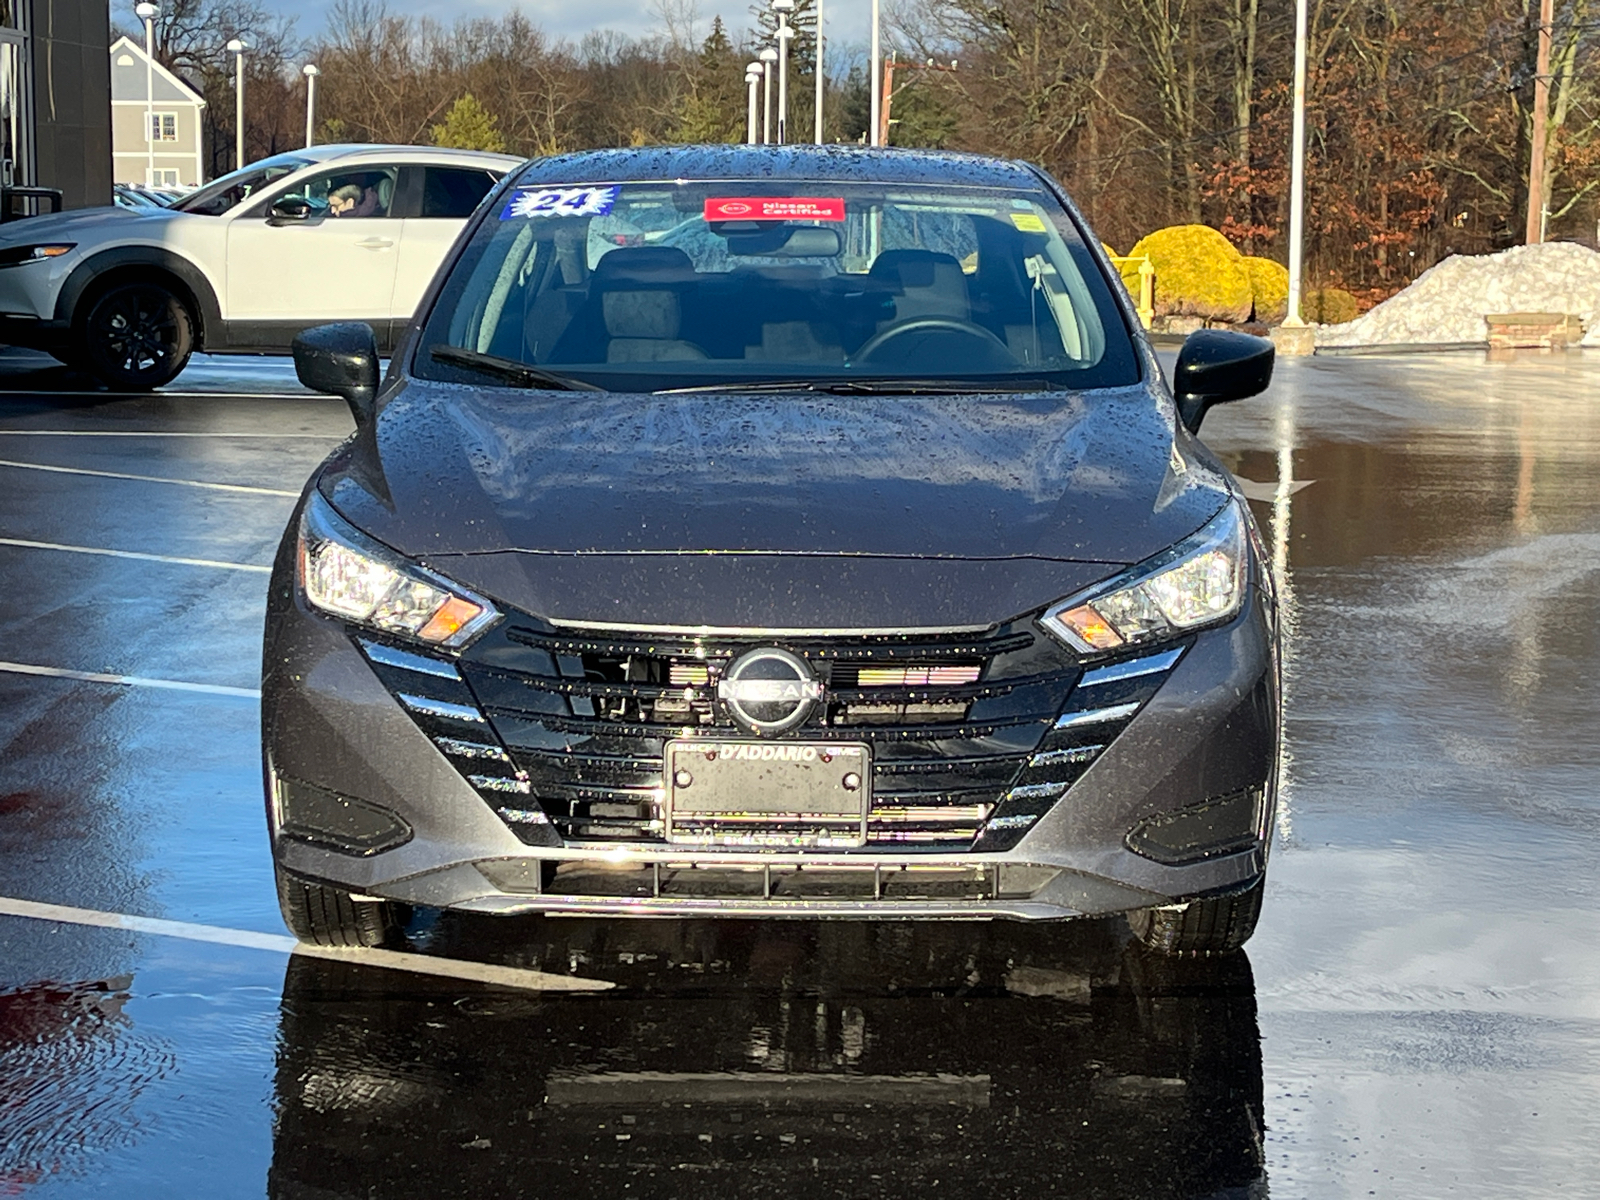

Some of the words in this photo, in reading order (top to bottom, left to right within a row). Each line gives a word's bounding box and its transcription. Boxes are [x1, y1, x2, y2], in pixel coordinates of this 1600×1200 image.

[530, 193, 591, 211] 24
[762, 208, 832, 216] Certified
[721, 683, 818, 698] NISAN
[719, 744, 817, 761] D'ADDARIO
[826, 747, 861, 756] GMC
